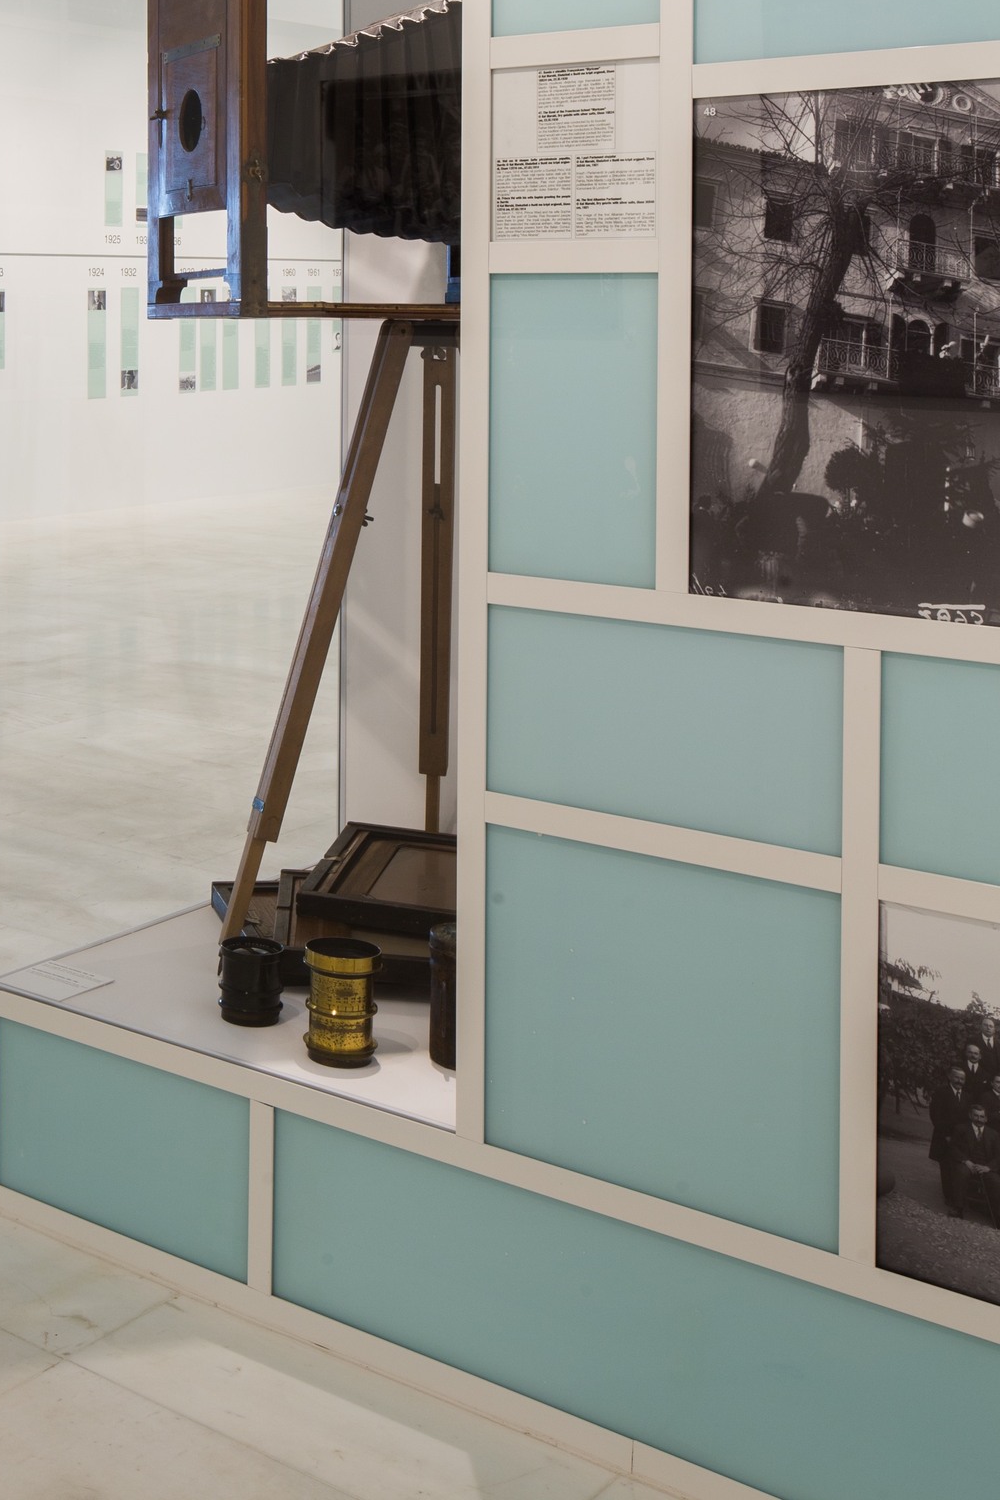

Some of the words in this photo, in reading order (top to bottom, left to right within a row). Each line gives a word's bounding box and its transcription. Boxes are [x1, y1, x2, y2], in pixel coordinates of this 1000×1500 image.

[704, 107, 716, 116] 48
[105, 235, 121, 244] 1925
[88, 268, 104, 277] 1924
[121, 268, 137, 277] 1932
